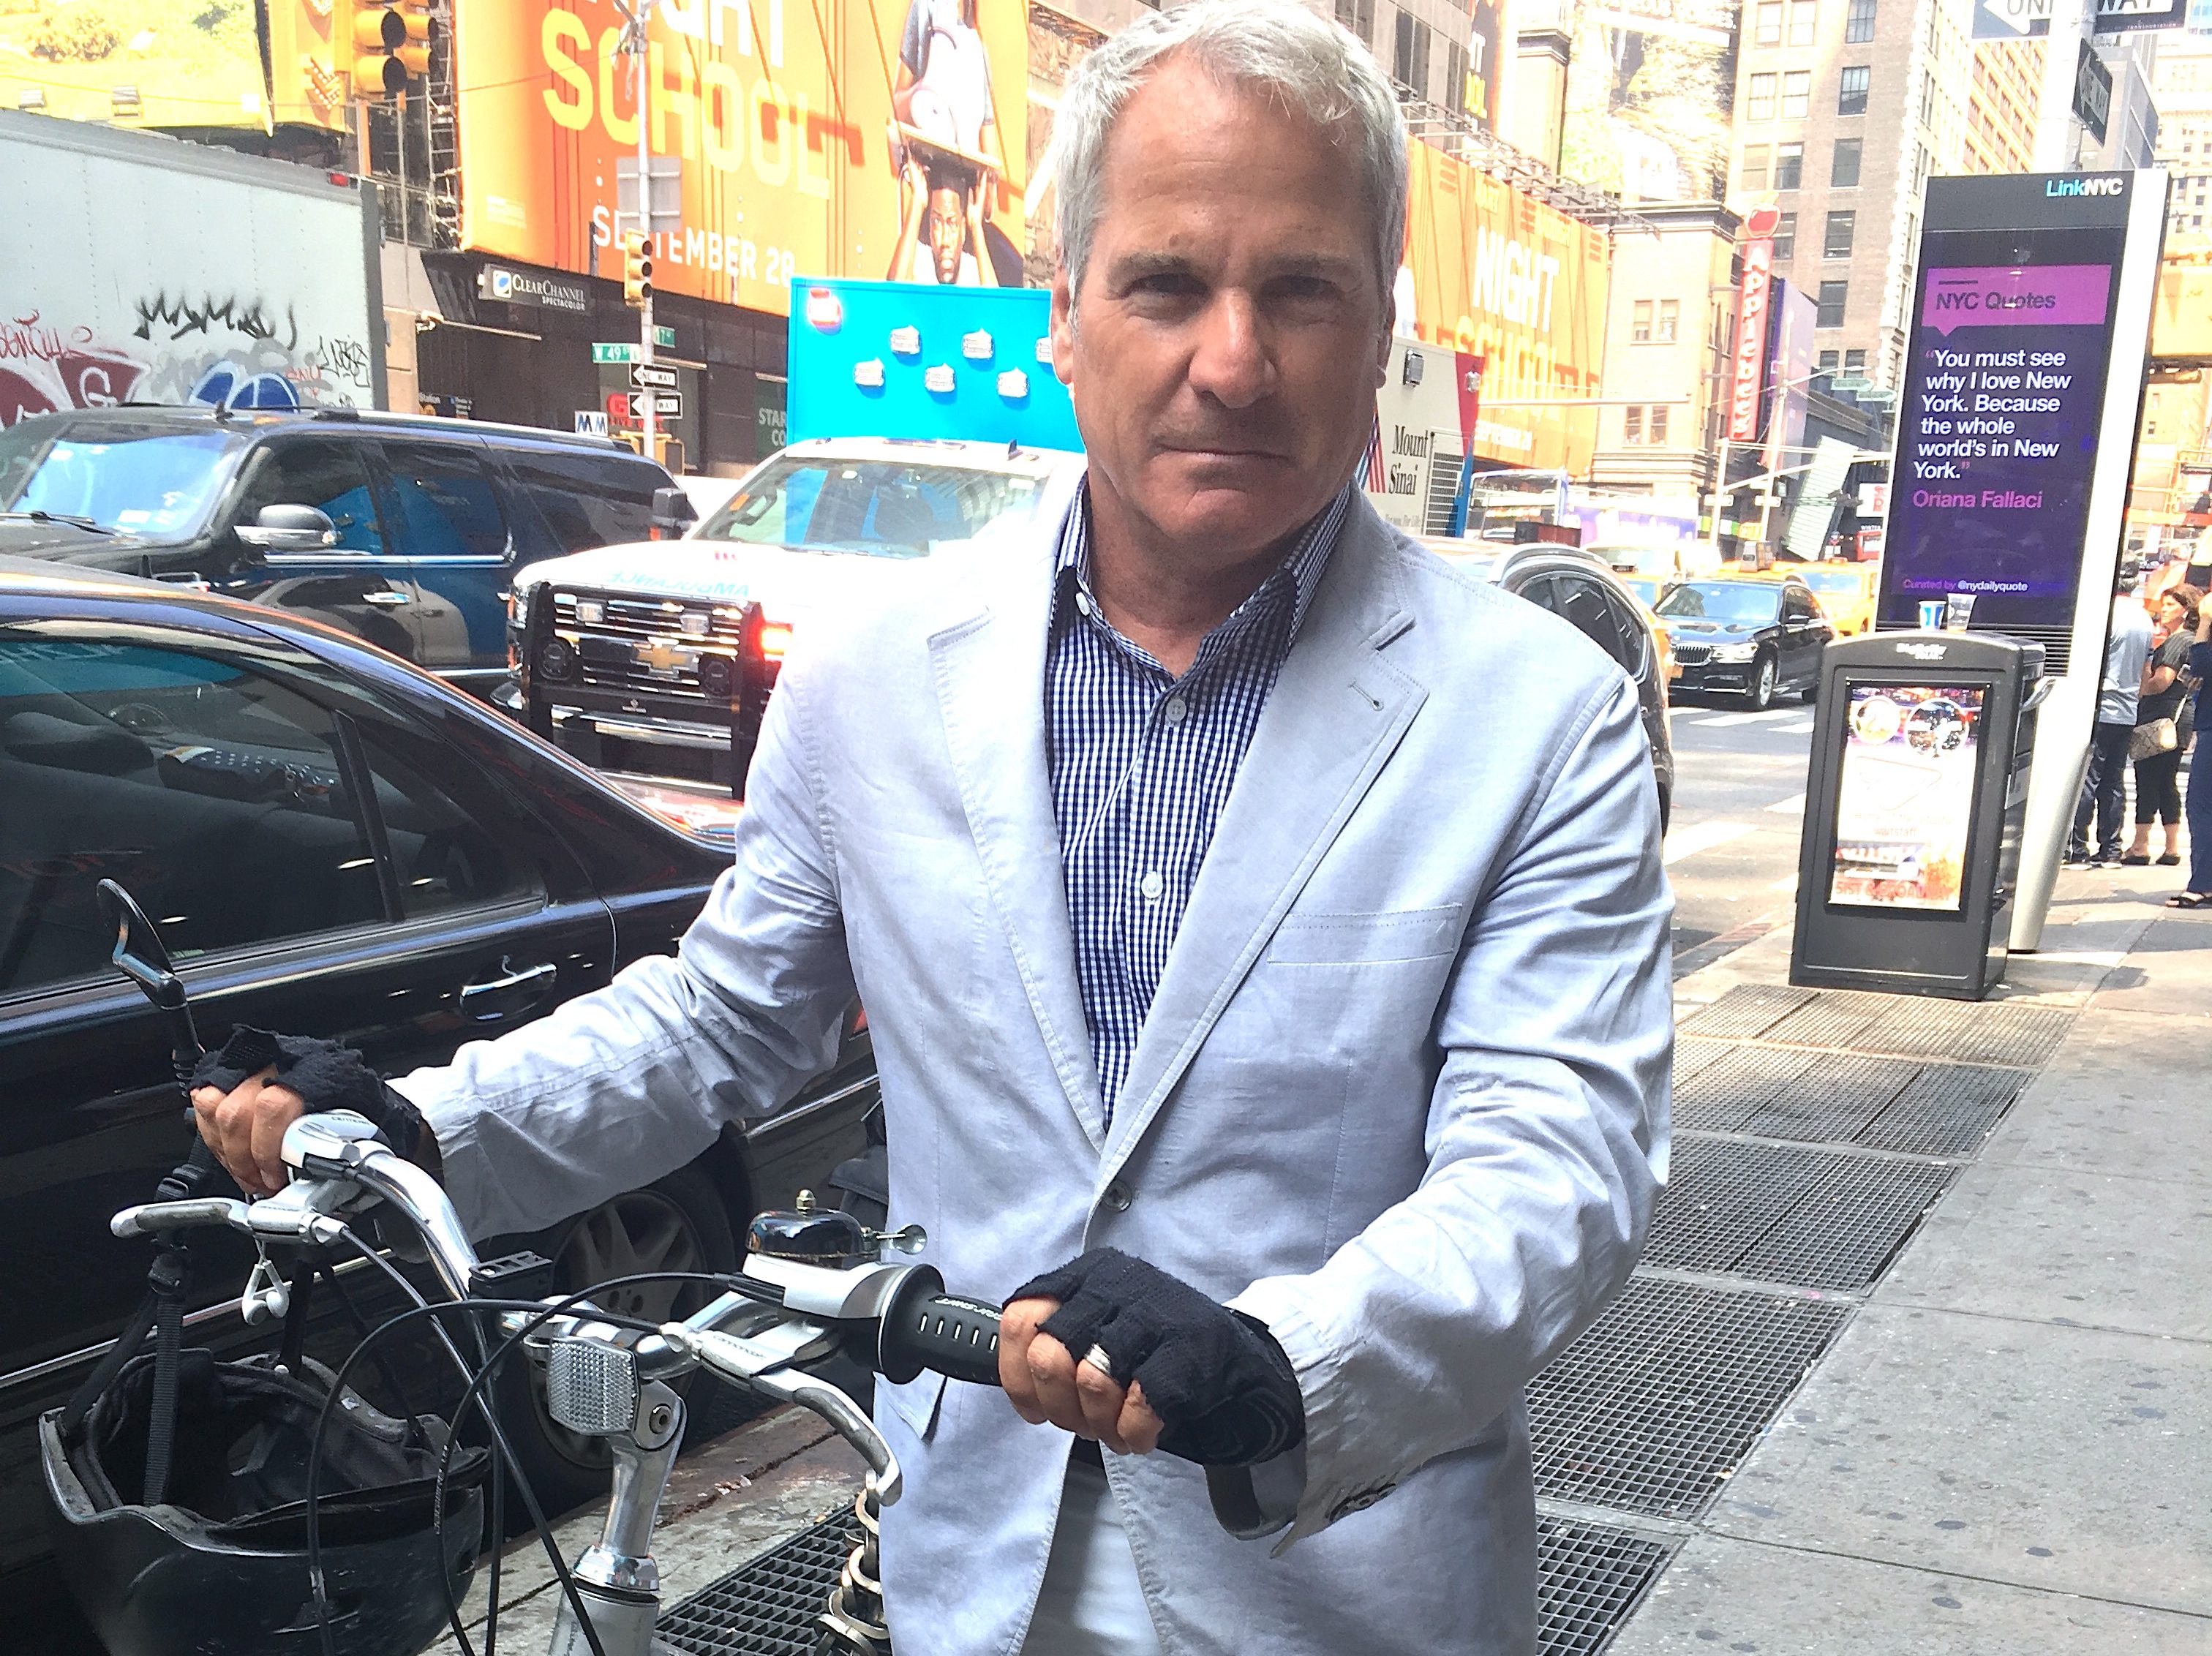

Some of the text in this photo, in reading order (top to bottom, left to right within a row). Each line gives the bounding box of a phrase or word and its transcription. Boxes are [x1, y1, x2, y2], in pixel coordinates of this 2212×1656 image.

[541, 7, 830, 200] SCHOOL
[2047, 179, 2123, 197] LinkNYC
[593, 206, 795, 288] SETEMBER 28
[1472, 225, 1560, 333] NIGHT
[542, 296, 585, 311] SPECTACOLOR
[1936, 292, 2056, 310] NYC Quotes
[1975, 349, 2025, 367] must
[2030, 351, 2066, 367] see
[658, 374, 672, 383] WAY
[1926, 371, 2072, 393] why I love New
[1922, 394, 2061, 413] York. Because
[1920, 417, 2015, 435] the whole
[1392, 425, 1429, 459] Mount
[1991, 440, 2009, 457] in
[2014, 440, 2060, 457] New
[1389, 462, 1418, 495] Sinai
[1912, 489, 2043, 509] Oriana Fallaci
[1903, 579, 2028, 592] Curated by @nydailyquote
